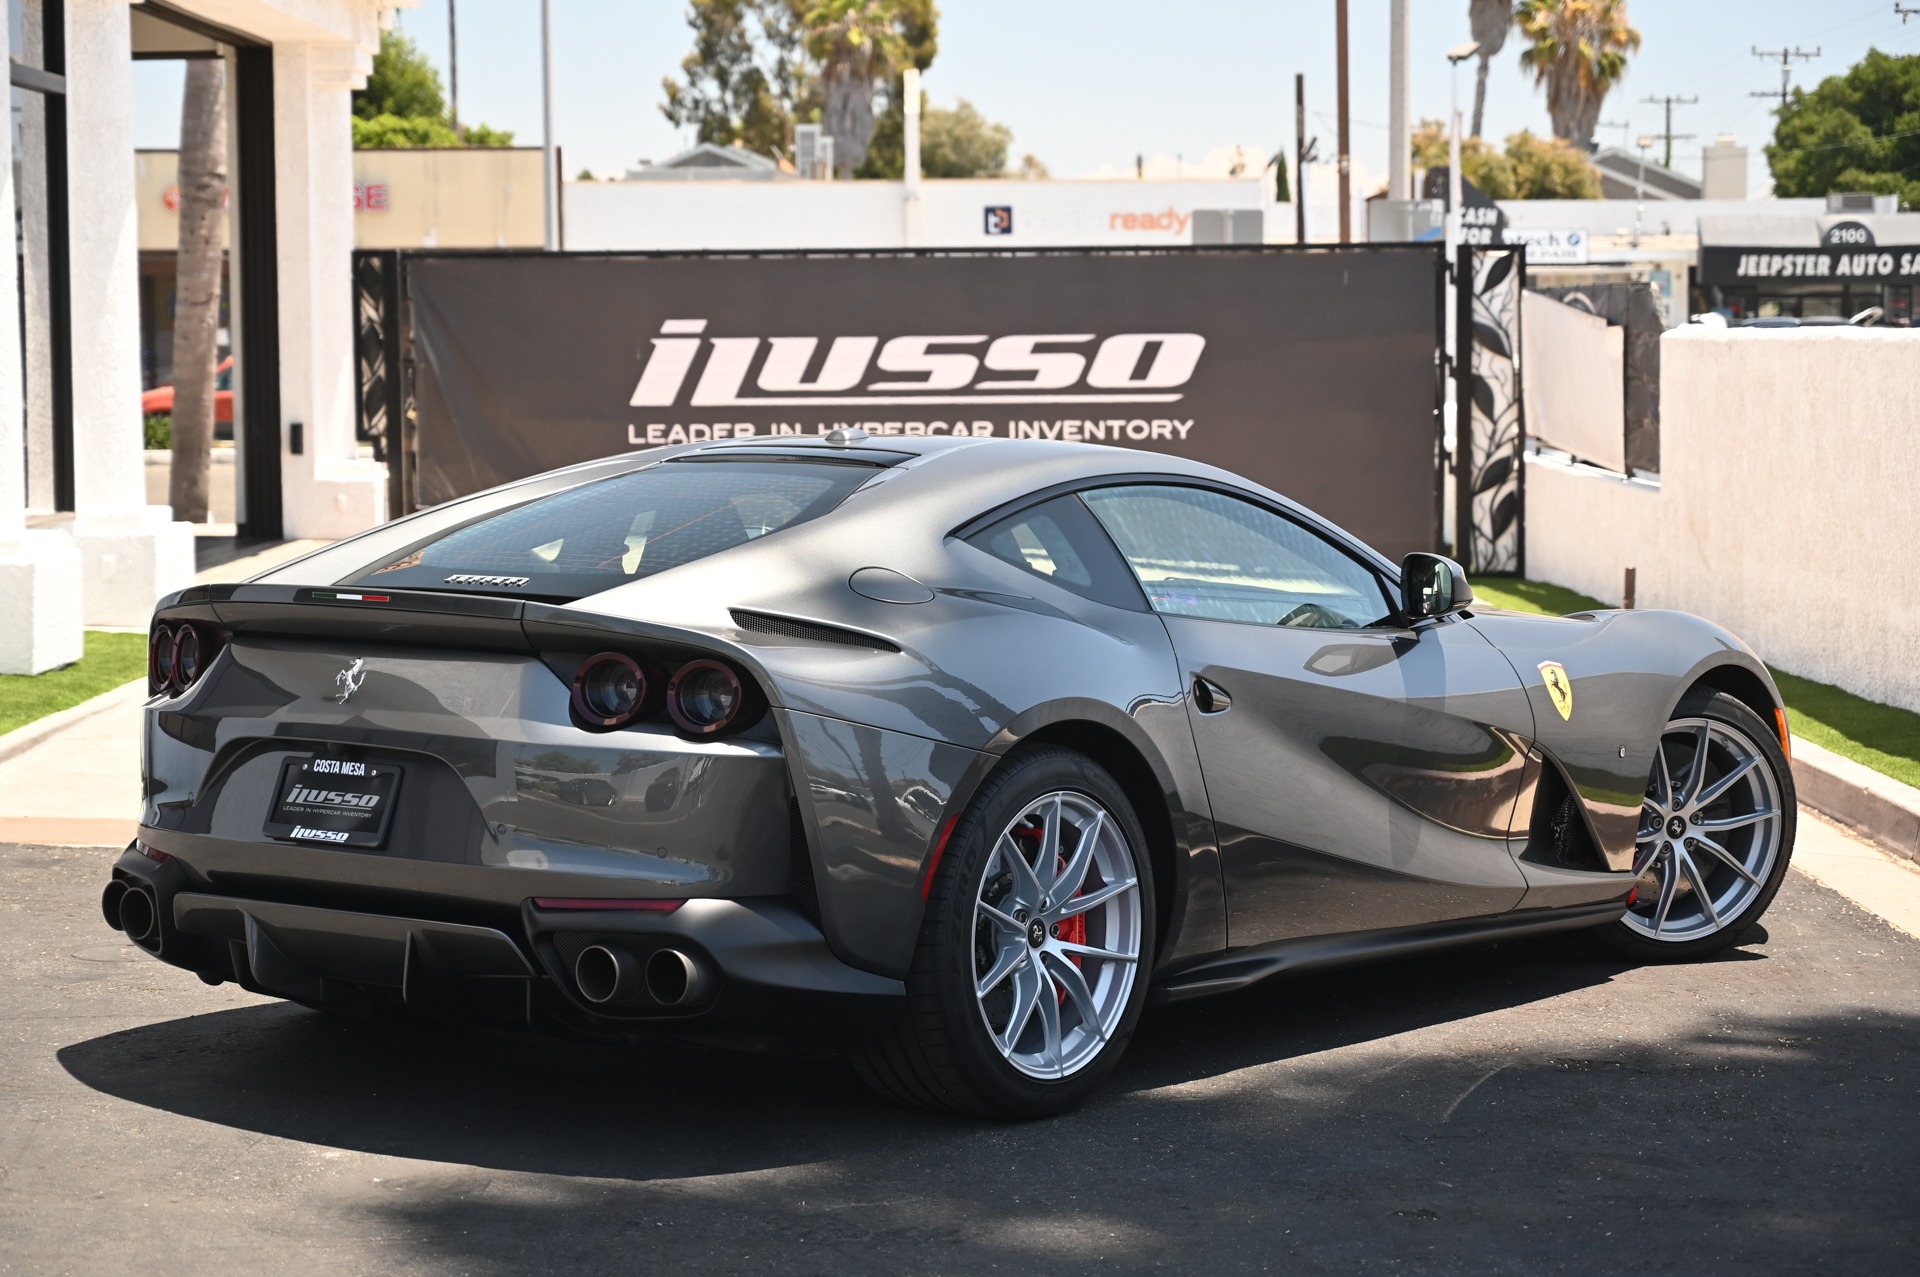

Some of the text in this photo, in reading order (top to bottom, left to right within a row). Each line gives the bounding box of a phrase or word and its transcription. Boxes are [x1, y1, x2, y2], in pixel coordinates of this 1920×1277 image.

[1109, 207, 1190, 236] ready
[1830, 228, 1867, 244] 2100
[1737, 254, 1831, 277] JEEPSTER
[1836, 253, 1894, 276] AUTO
[628, 423, 755, 444] LEADER
[1009, 419, 1194, 441] INVENTORY
[313, 759, 365, 776] COSTA MESA
[283, 805, 304, 813] LEADER
[312, 808, 341, 816] HYPERCAR
[342, 811, 373, 819] INVENTORY
